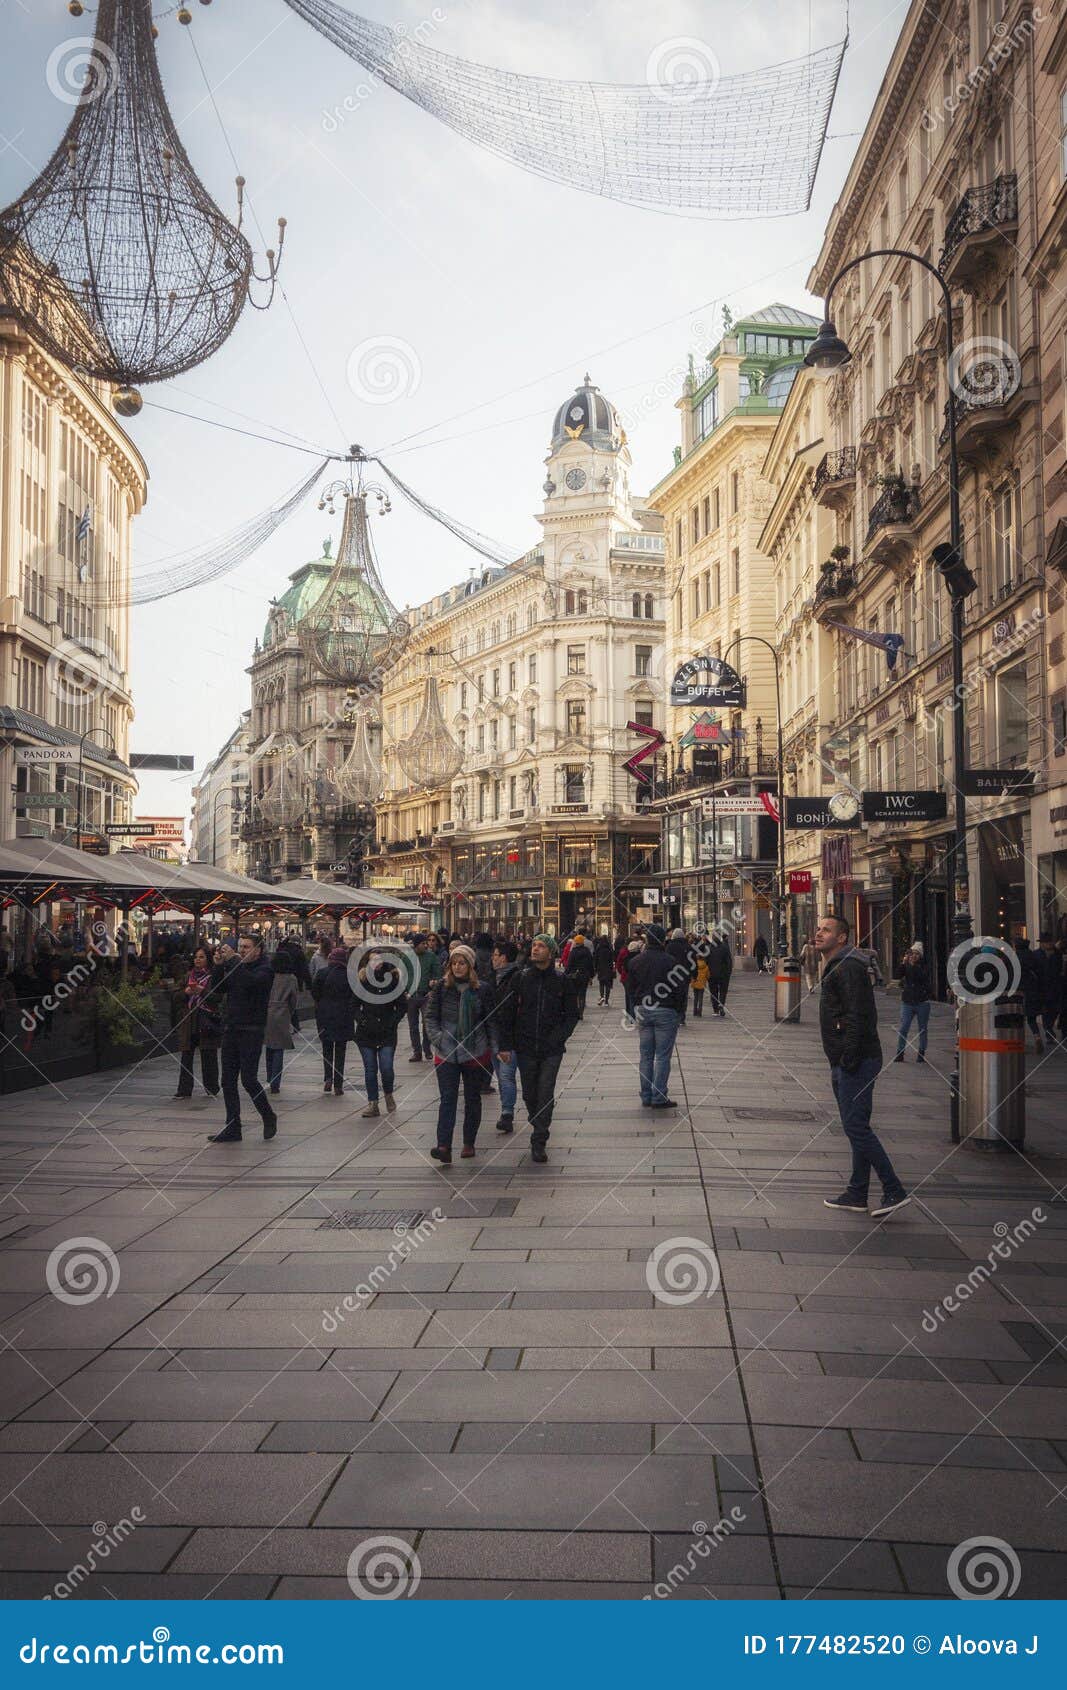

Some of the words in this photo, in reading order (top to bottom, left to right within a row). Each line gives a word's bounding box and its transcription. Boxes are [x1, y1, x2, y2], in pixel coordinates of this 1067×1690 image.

[687, 686, 727, 697] BUFFET
[23, 750, 73, 760] PANDORA
[977, 778, 1013, 788] BALLY
[885, 796, 914, 809] IWC
[791, 874, 810, 882] högl
